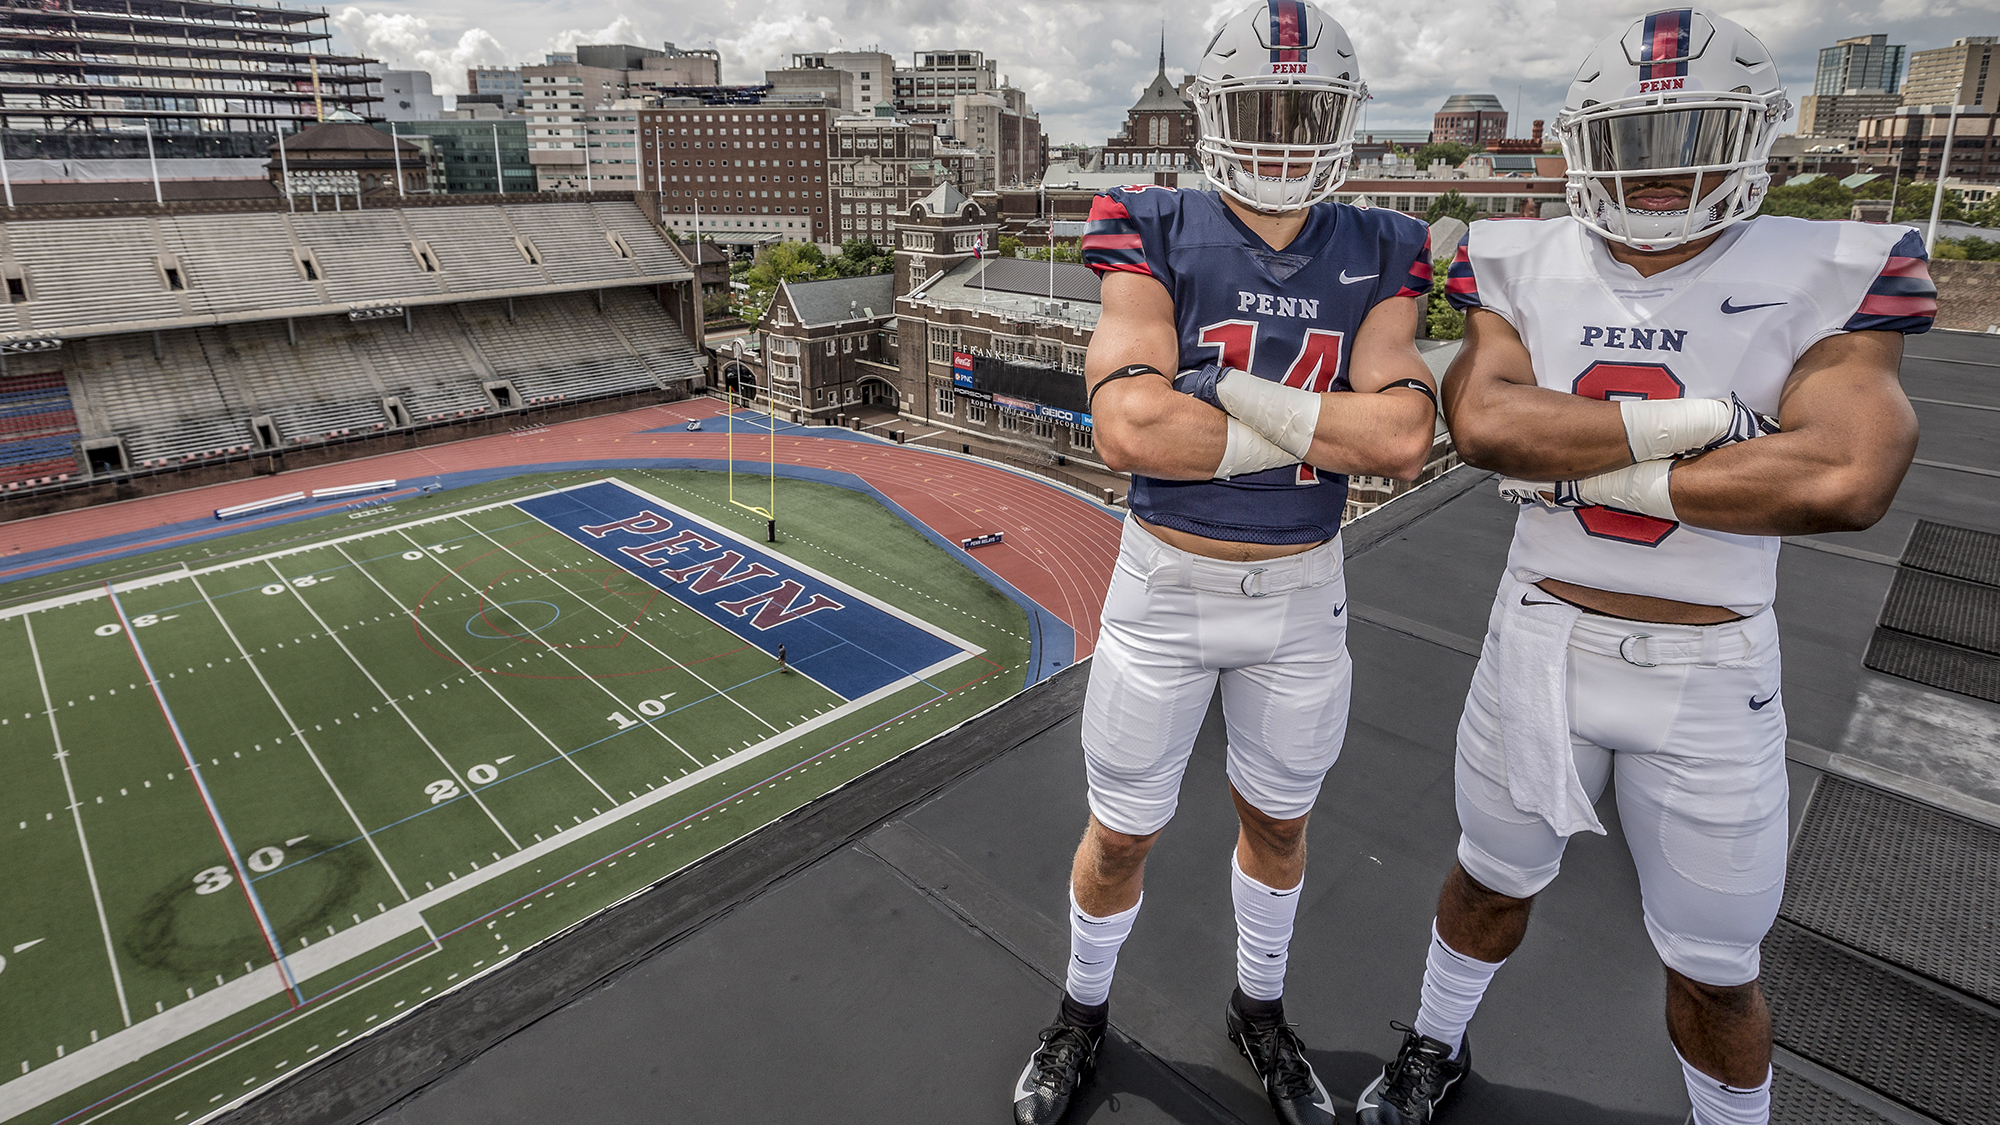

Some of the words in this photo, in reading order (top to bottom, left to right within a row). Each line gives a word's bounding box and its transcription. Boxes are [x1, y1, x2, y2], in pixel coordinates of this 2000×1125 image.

[1272, 64, 1307, 74] PENN
[1639, 78, 1685, 93] PENN
[1237, 291, 1320, 319] PENN
[1580, 325, 1688, 353] PENN
[963, 345, 1023, 362] FRANKLIN
[1053, 361, 1085, 376] FIEL
[960, 374, 973, 384] PNC
[954, 387, 992, 401] PORSCHE
[971, 399, 997, 410] ROBERT
[1055, 418, 1092, 432] SCOREBO
[1041, 406, 1073, 421] GEICO
[578, 510, 845, 631] PENN
[606, 699, 667, 730] 10
[424, 763, 499, 804] 20
[192, 846, 285, 895] 30
